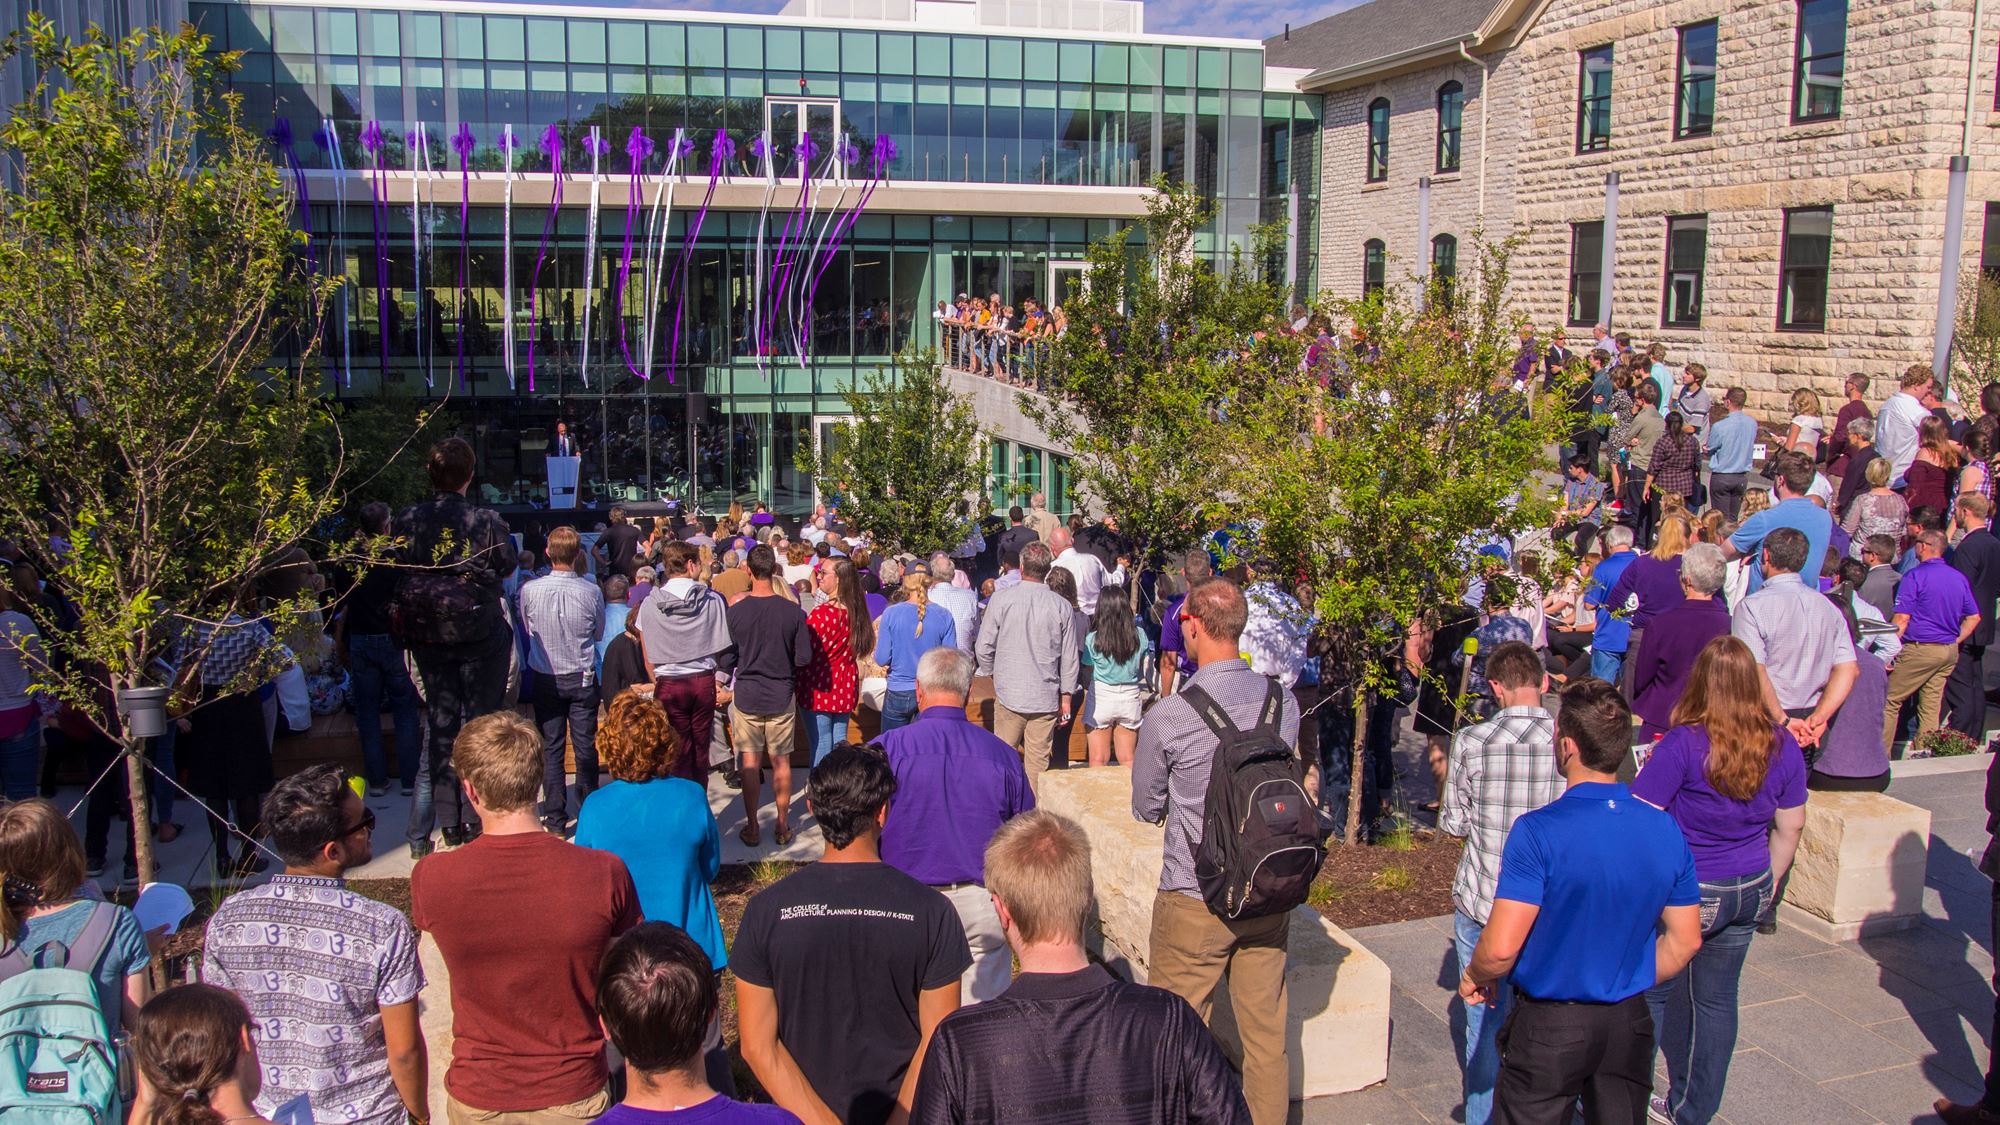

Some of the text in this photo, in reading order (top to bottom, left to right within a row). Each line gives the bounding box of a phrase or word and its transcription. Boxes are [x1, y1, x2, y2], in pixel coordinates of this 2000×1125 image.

[793, 904, 820, 913] COLLEGE
[892, 912, 915, 921] K-STATE
[28, 1077, 66, 1087] trans
